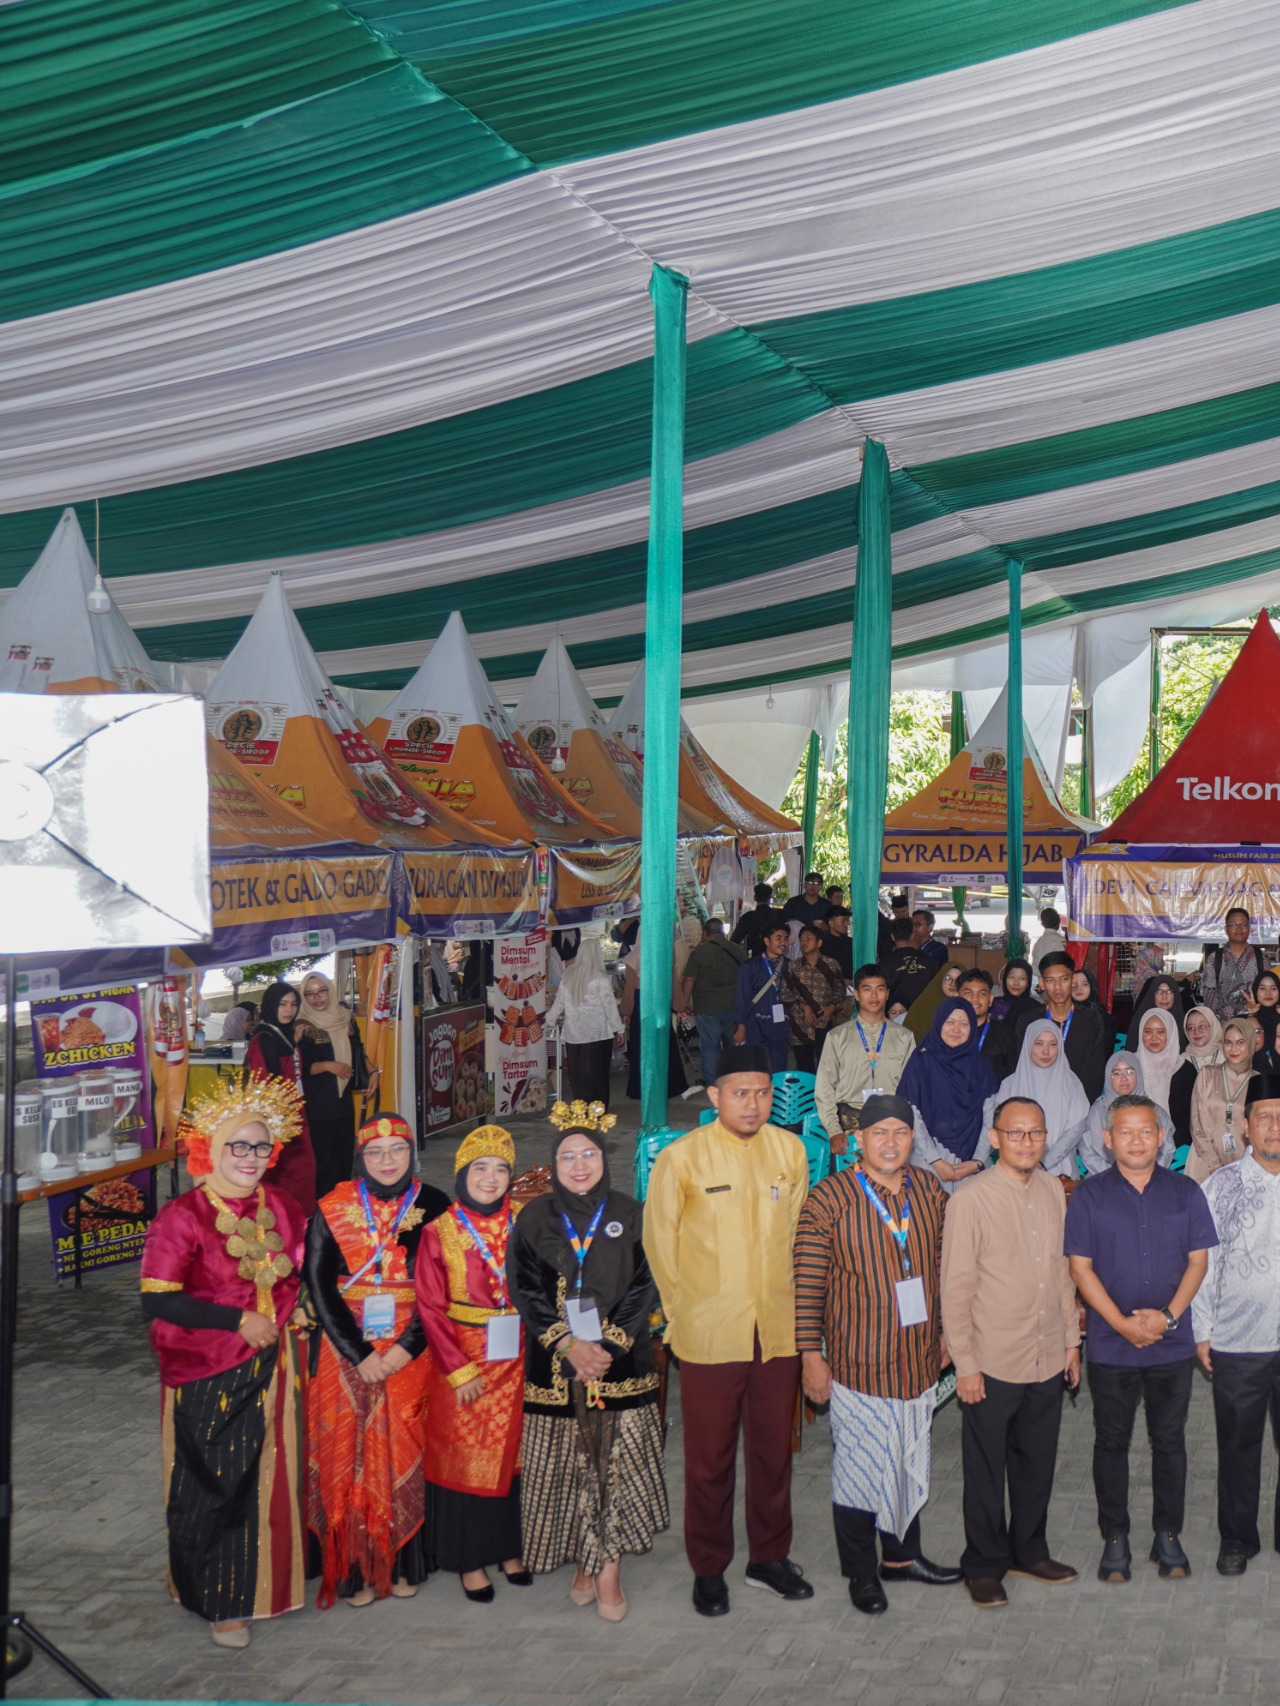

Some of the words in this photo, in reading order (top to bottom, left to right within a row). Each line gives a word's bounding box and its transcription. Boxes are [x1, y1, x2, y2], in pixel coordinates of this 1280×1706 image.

[883, 844, 993, 863] GYRALDA
[999, 844, 1063, 866] HJAB
[211, 876, 262, 912] OTEK
[285, 869, 391, 904] GADO-GADO
[408, 867, 478, 899] JURAGAN
[1095, 879, 1135, 895] DEVI
[501, 945, 536, 956] Dimsum
[501, 956, 530, 965] Mentai
[44, 1041, 136, 1066] ZCHICKEN
[433, 1046, 453, 1068] Dim
[503, 1060, 538, 1071] Dimsum
[502, 1070, 529, 1080] Tartar
[53, 1099, 63, 1108] ES
[85, 1096, 110, 1106] MILO
[57, 1231, 94, 1251] ME
[97, 1220, 150, 1243] PEDA
[83, 1244, 120, 1257] GORENG
[64, 1260, 94, 1272] BAMI
[96, 1251, 135, 1264] GORENG
